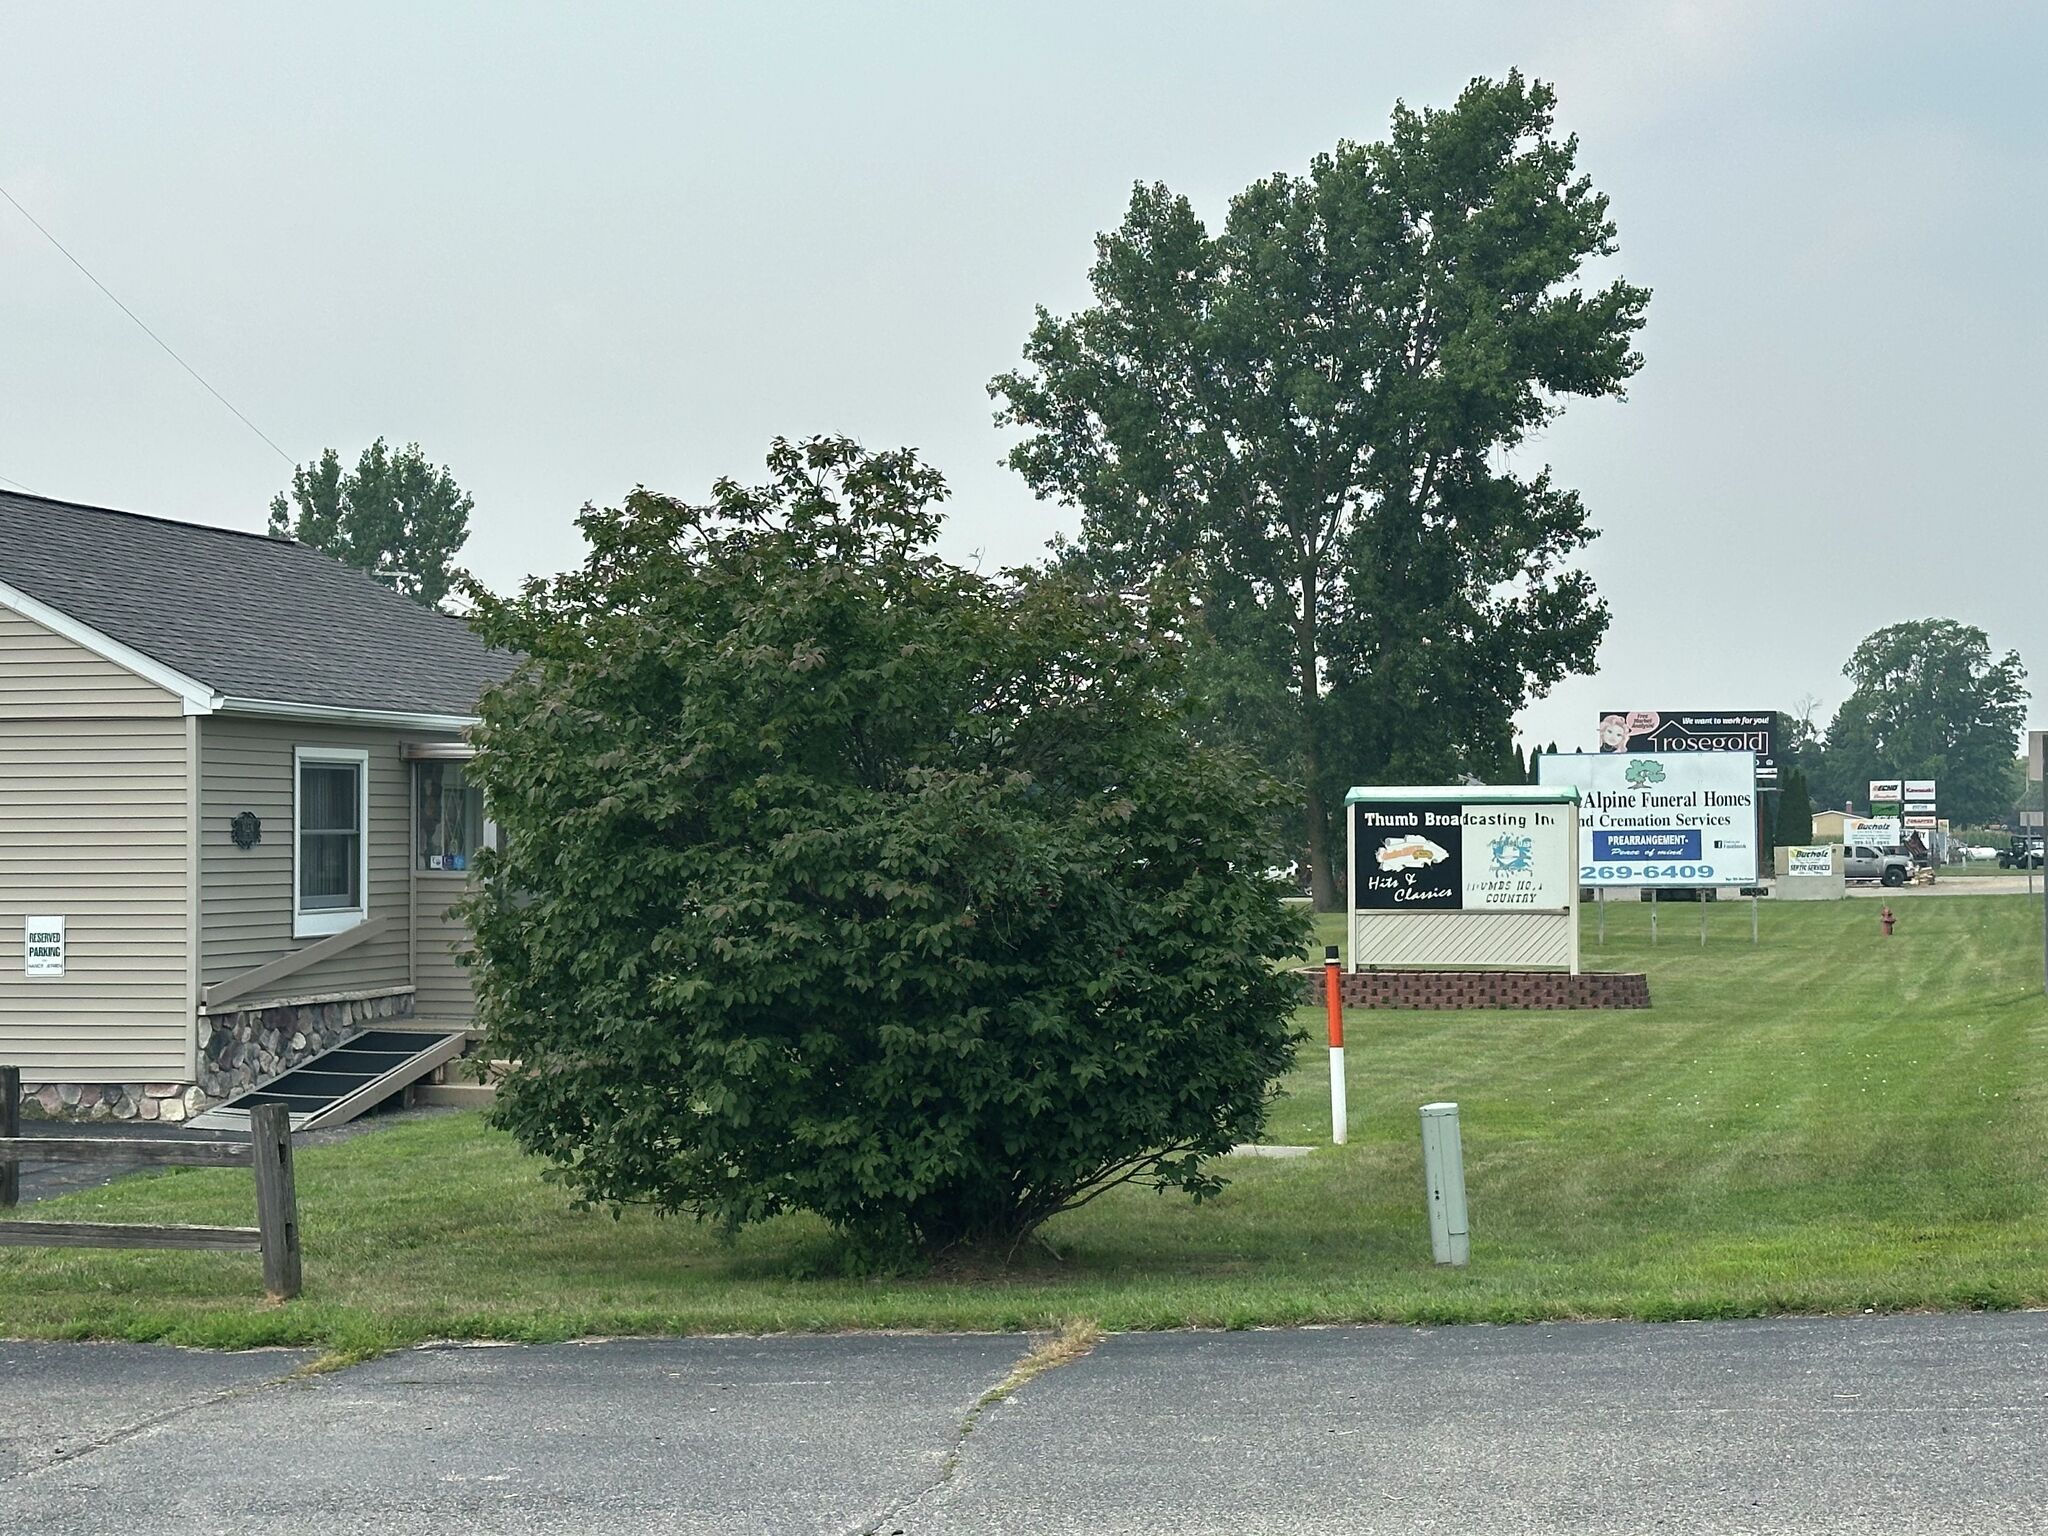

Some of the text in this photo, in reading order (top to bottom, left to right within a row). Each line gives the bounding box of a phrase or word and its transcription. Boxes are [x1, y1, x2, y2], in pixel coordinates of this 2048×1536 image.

[1682, 717, 1769, 726] We want to work for you!
[1663, 732, 1762, 751] rosegold
[1584, 791, 1751, 813] Alpine Funeral Homes
[1364, 812, 1418, 827] Thumb
[1425, 812, 1526, 828] Broadcasting
[1600, 814, 1670, 827] Cremation
[1676, 813, 1731, 827] Services
[1610, 848, 1683, 858] Peace of mind
[1580, 865, 1714, 879] 269-6409
[1368, 873, 1417, 890] Hits &
[1394, 887, 1453, 902] Classics
[1486, 893, 1537, 904] COUNTRY
[29, 932, 61, 943] RESERVED
[29, 946, 61, 957] PARKING
